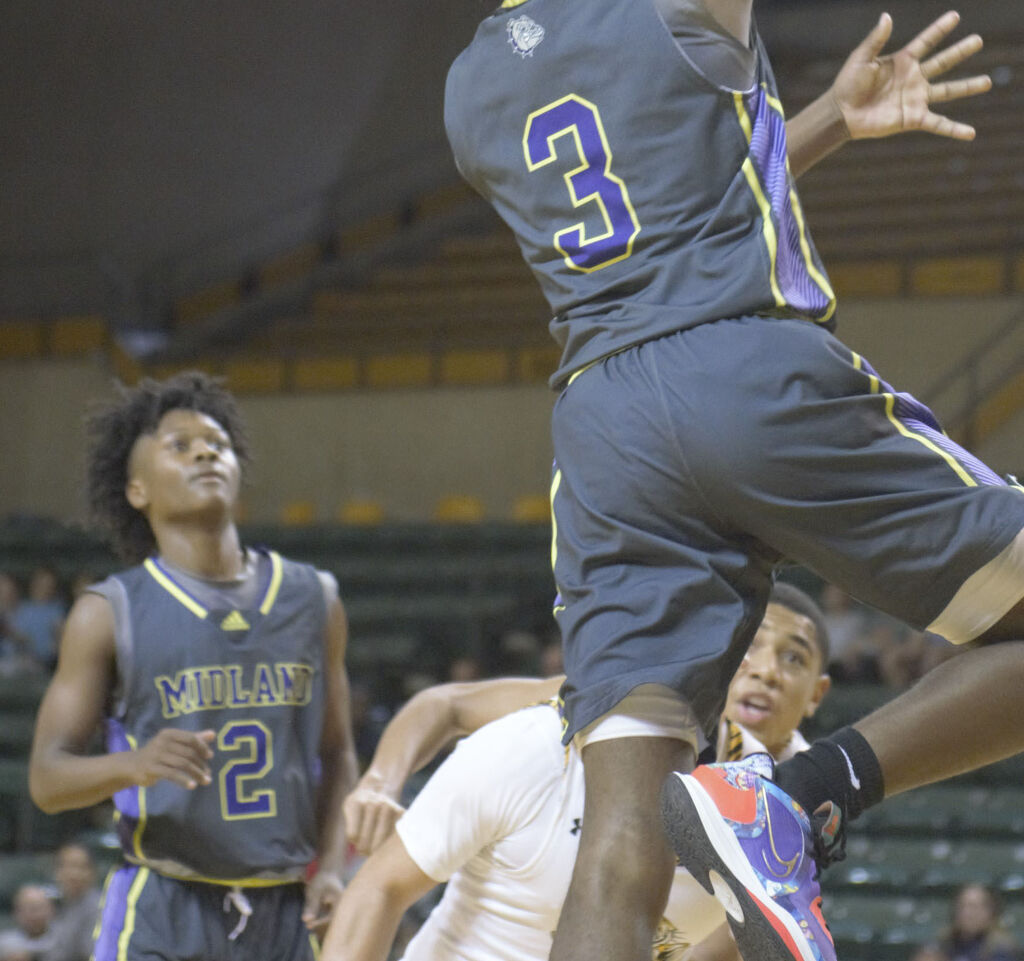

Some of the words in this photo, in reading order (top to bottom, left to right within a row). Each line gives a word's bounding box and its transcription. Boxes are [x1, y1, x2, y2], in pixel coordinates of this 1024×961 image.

[522, 93, 641, 274] 3
[154, 662, 313, 719] MIDLAND
[218, 719, 277, 821] 2
